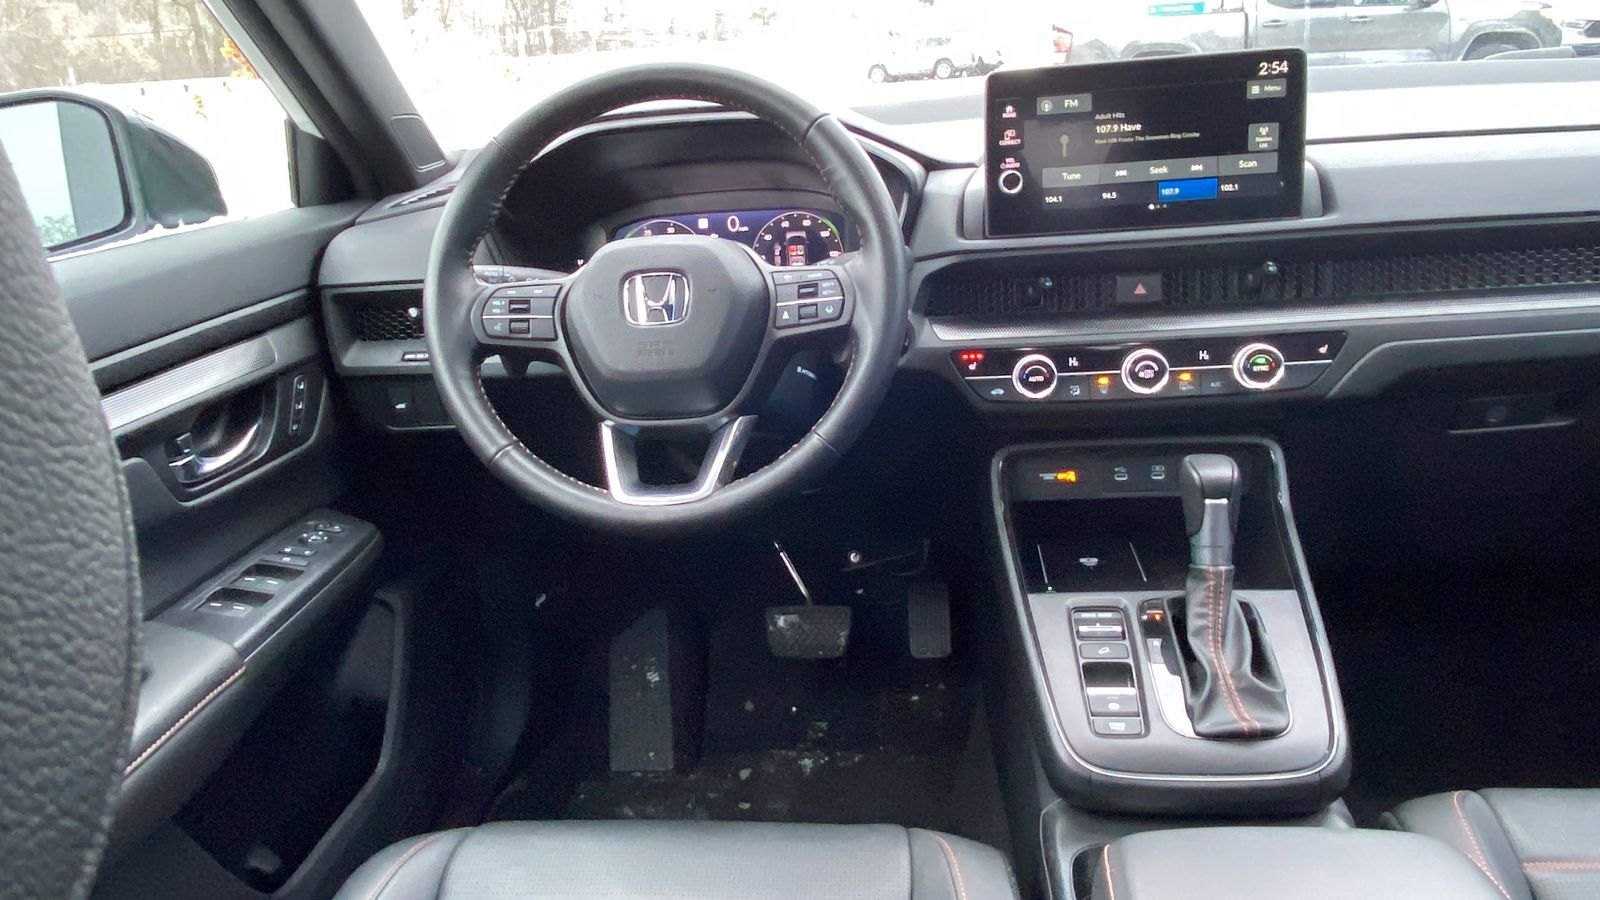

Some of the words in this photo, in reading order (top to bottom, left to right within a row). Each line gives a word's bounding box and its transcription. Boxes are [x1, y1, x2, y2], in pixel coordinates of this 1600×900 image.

[1258, 60, 1289, 76] 2:54
[1263, 84, 1282, 92] Menu
[1064, 99, 1078, 108] FM
[1095, 124, 1119, 133] 107.9
[1120, 123, 1142, 132] Have
[1239, 160, 1258, 168] Scan
[1149, 165, 1168, 174] Seek
[1062, 172, 1081, 181] Tune
[1161, 187, 1180, 195] 107.9
[1220, 183, 1238, 192] 102.1
[1101, 192, 1117, 200] 94.5
